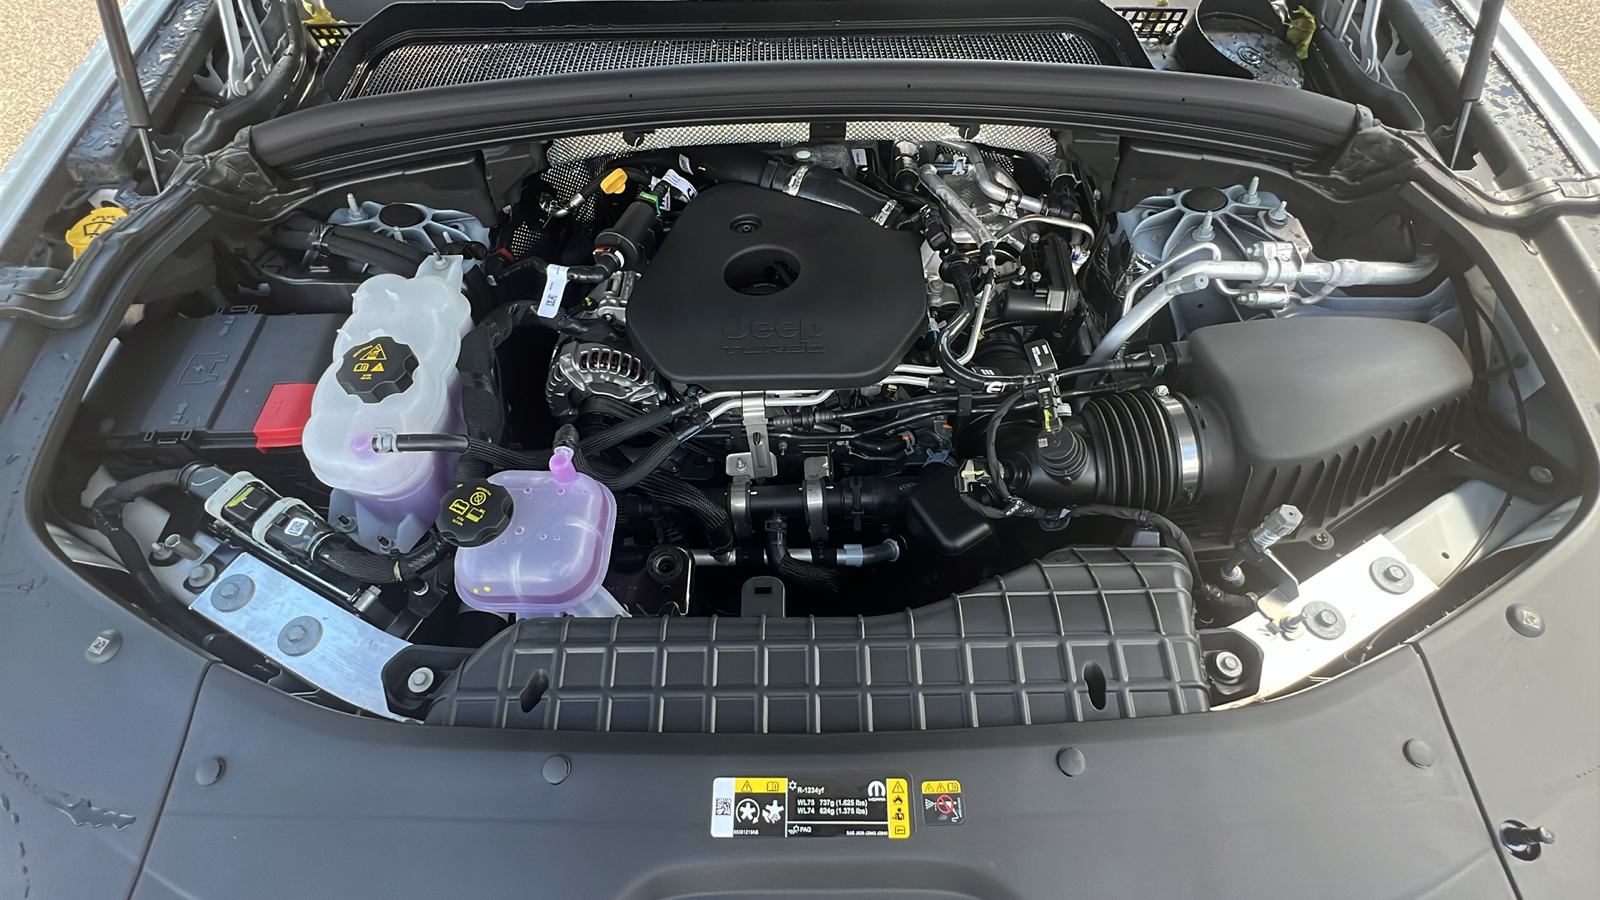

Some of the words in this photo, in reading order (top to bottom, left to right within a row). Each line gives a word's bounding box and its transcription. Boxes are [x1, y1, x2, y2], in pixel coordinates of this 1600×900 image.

[721, 315, 825, 344] Jeep
[721, 345, 827, 355] TURBO
[797, 786, 825, 795] R-1234yf
[819, 799, 835, 807] 737g
[835, 799, 855, 807] (1.625
[855, 799, 868, 807] lbs)
[797, 807, 815, 815] WL74
[819, 807, 835, 816] 624g
[835, 807, 855, 816] (1.375
[855, 807, 868, 816] lbs)
